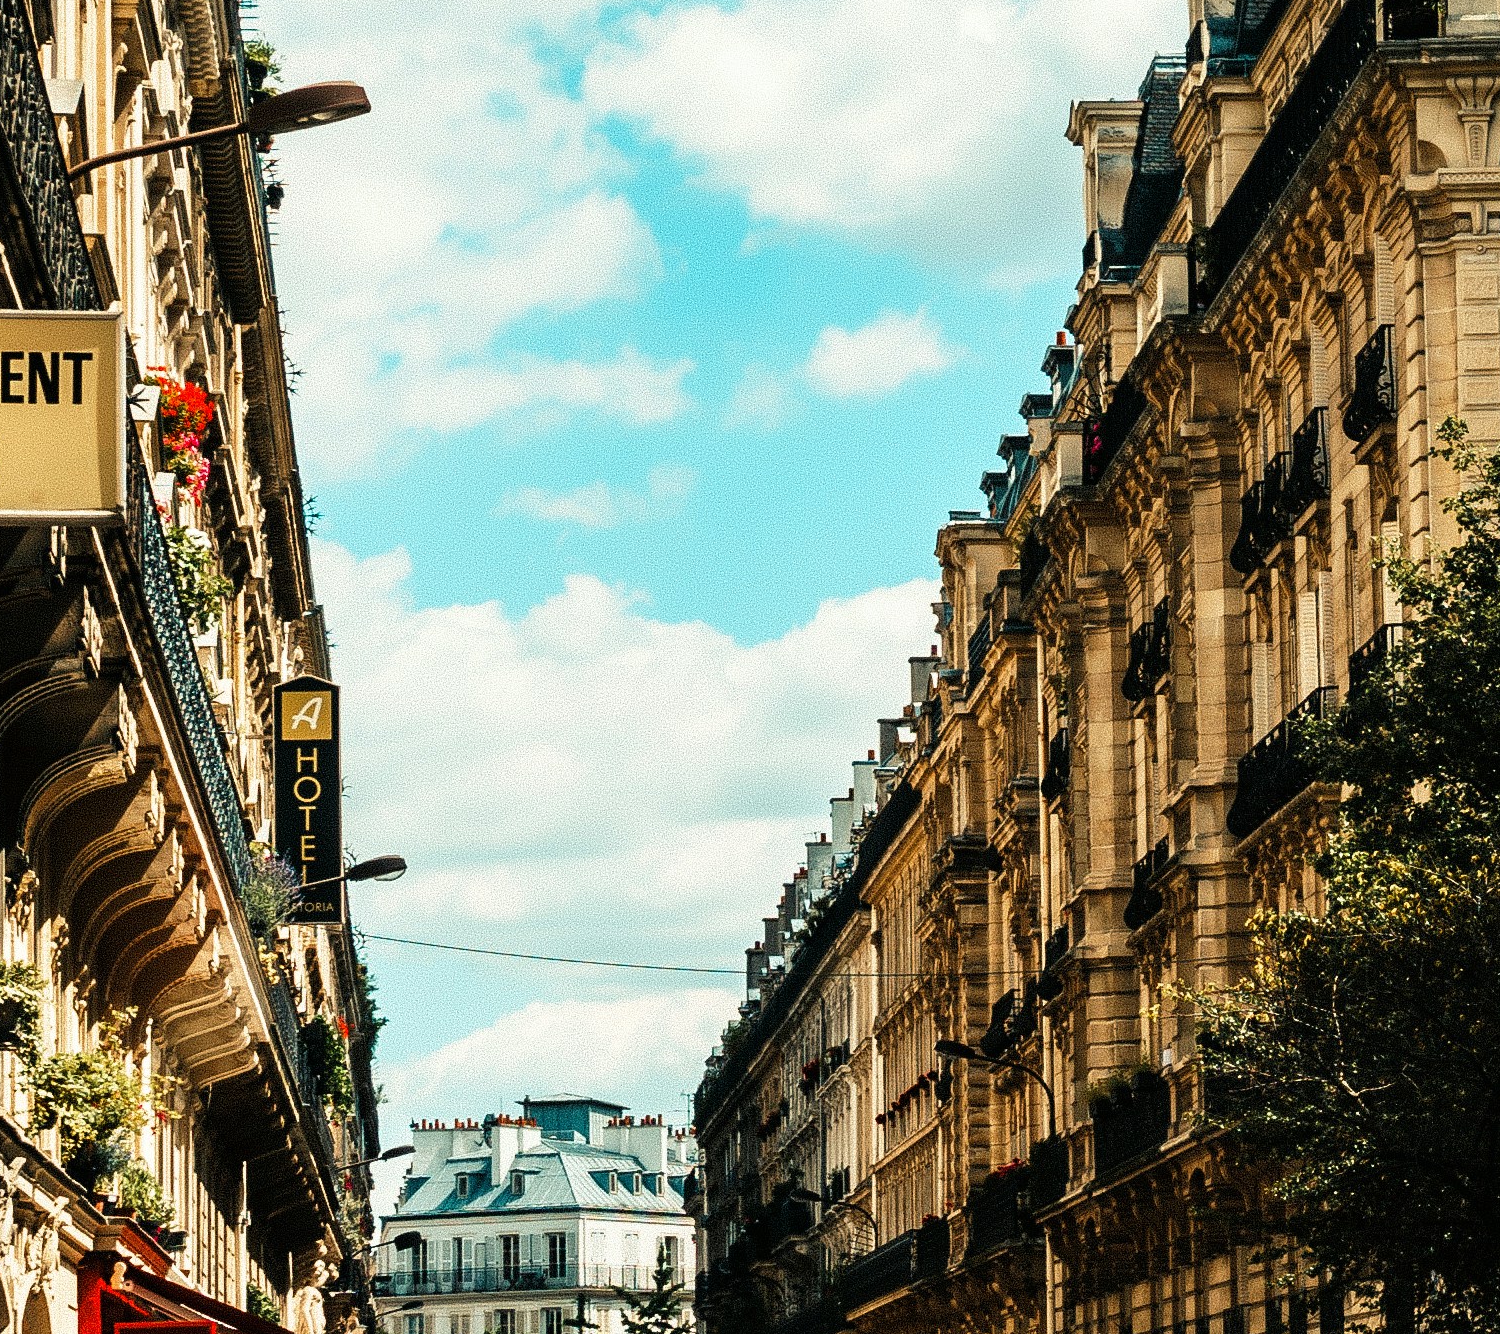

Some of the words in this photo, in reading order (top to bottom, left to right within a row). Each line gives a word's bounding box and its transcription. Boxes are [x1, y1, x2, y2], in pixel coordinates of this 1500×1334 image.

[291, 697, 323, 730] A
[293, 747, 322, 890] HOTEL
[290, 901, 334, 913] STORIA
